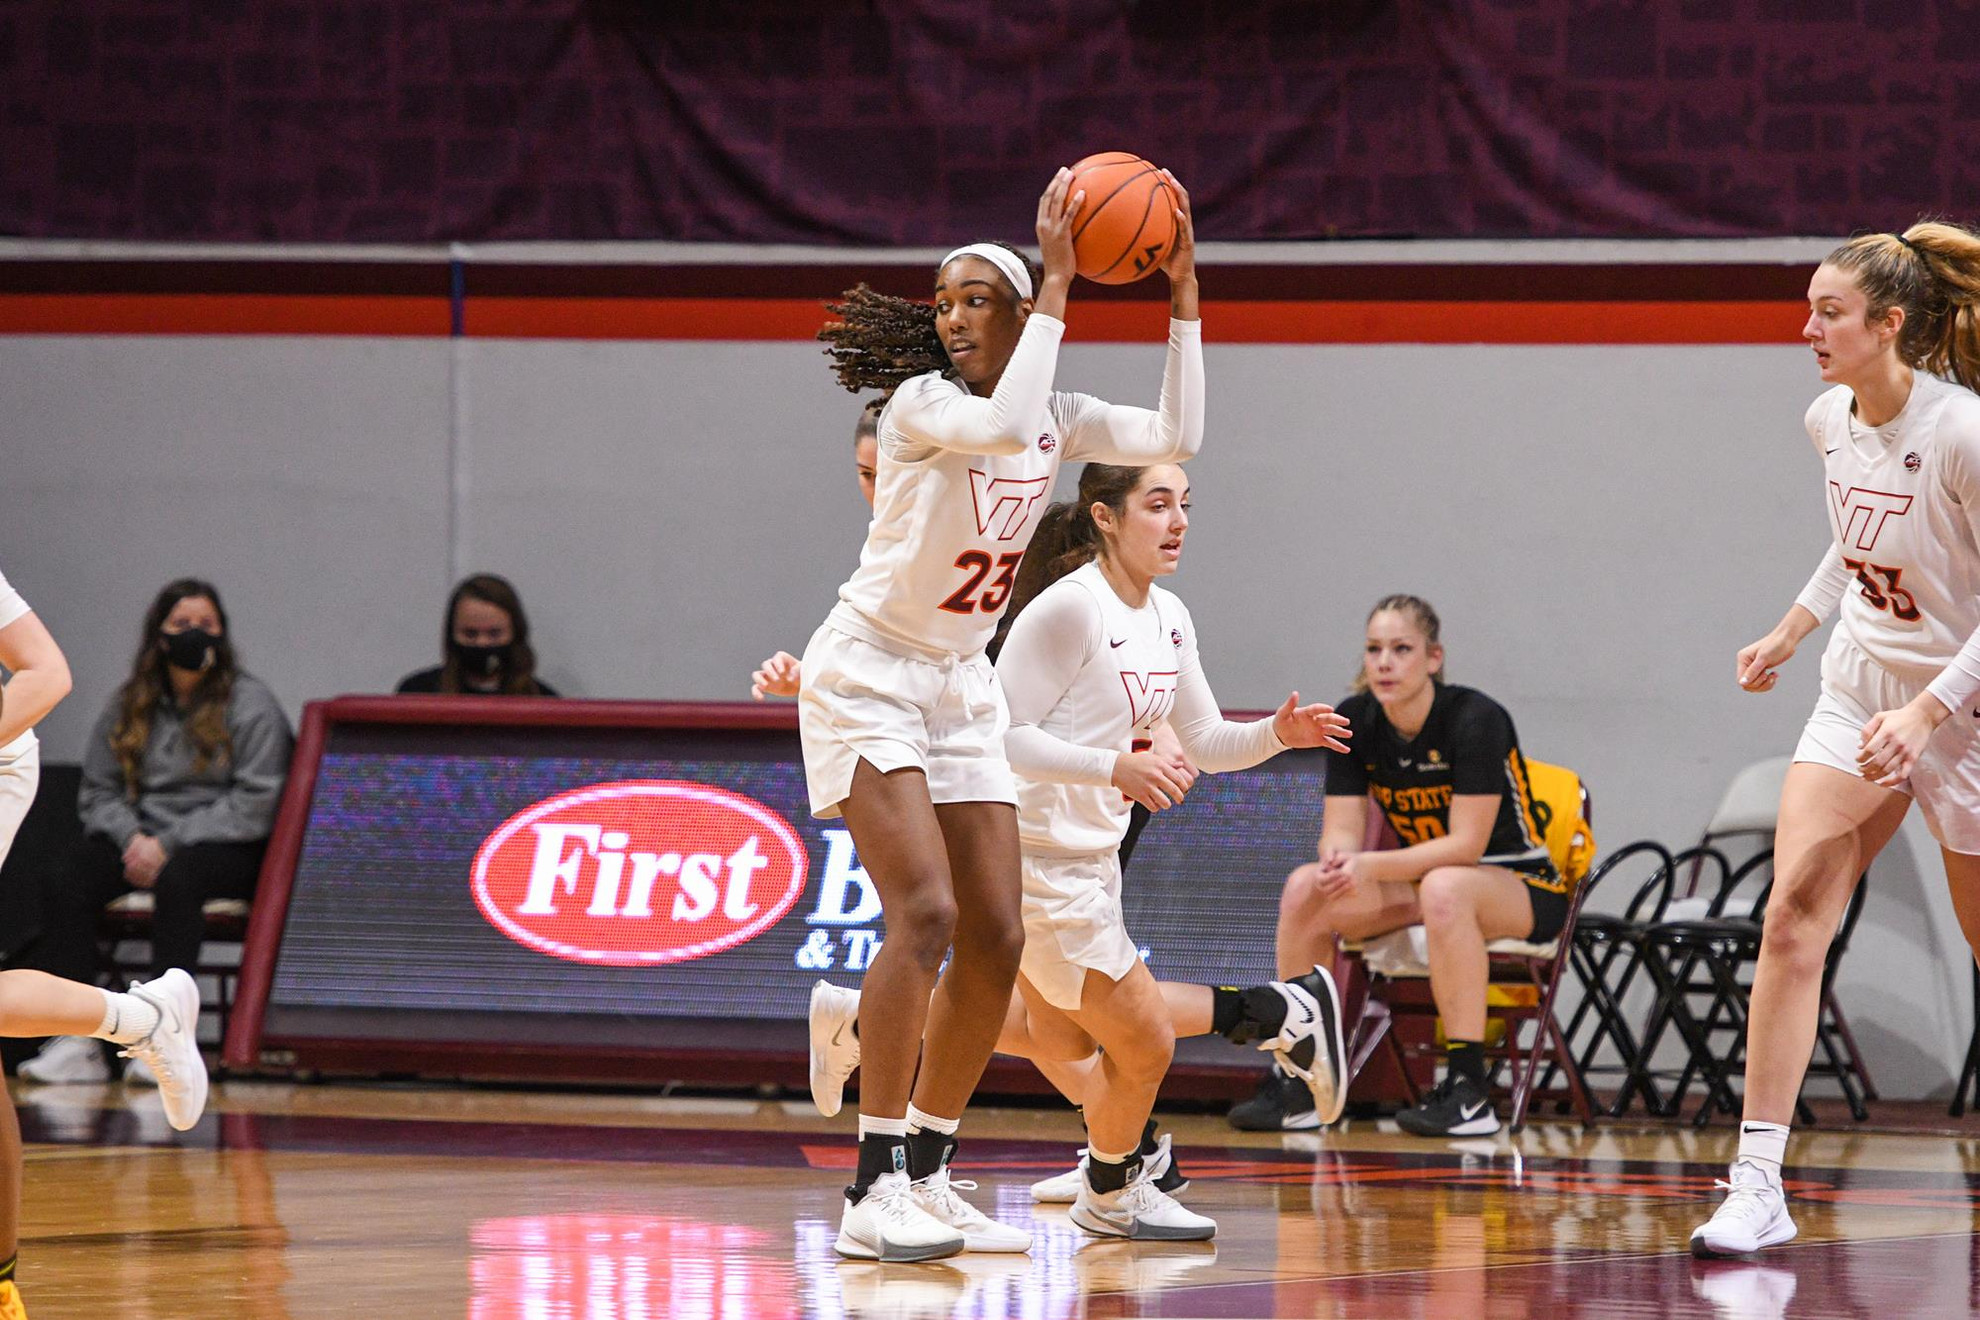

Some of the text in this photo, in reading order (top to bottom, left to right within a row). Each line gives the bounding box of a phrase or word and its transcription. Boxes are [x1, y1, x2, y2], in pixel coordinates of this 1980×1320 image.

[967, 467, 1050, 541] VT
[1829, 479, 1914, 552] VT
[937, 549, 1026, 615] 23
[1388, 811, 1446, 847] 50
[517, 822, 768, 922] First
[795, 928, 837, 970] &
